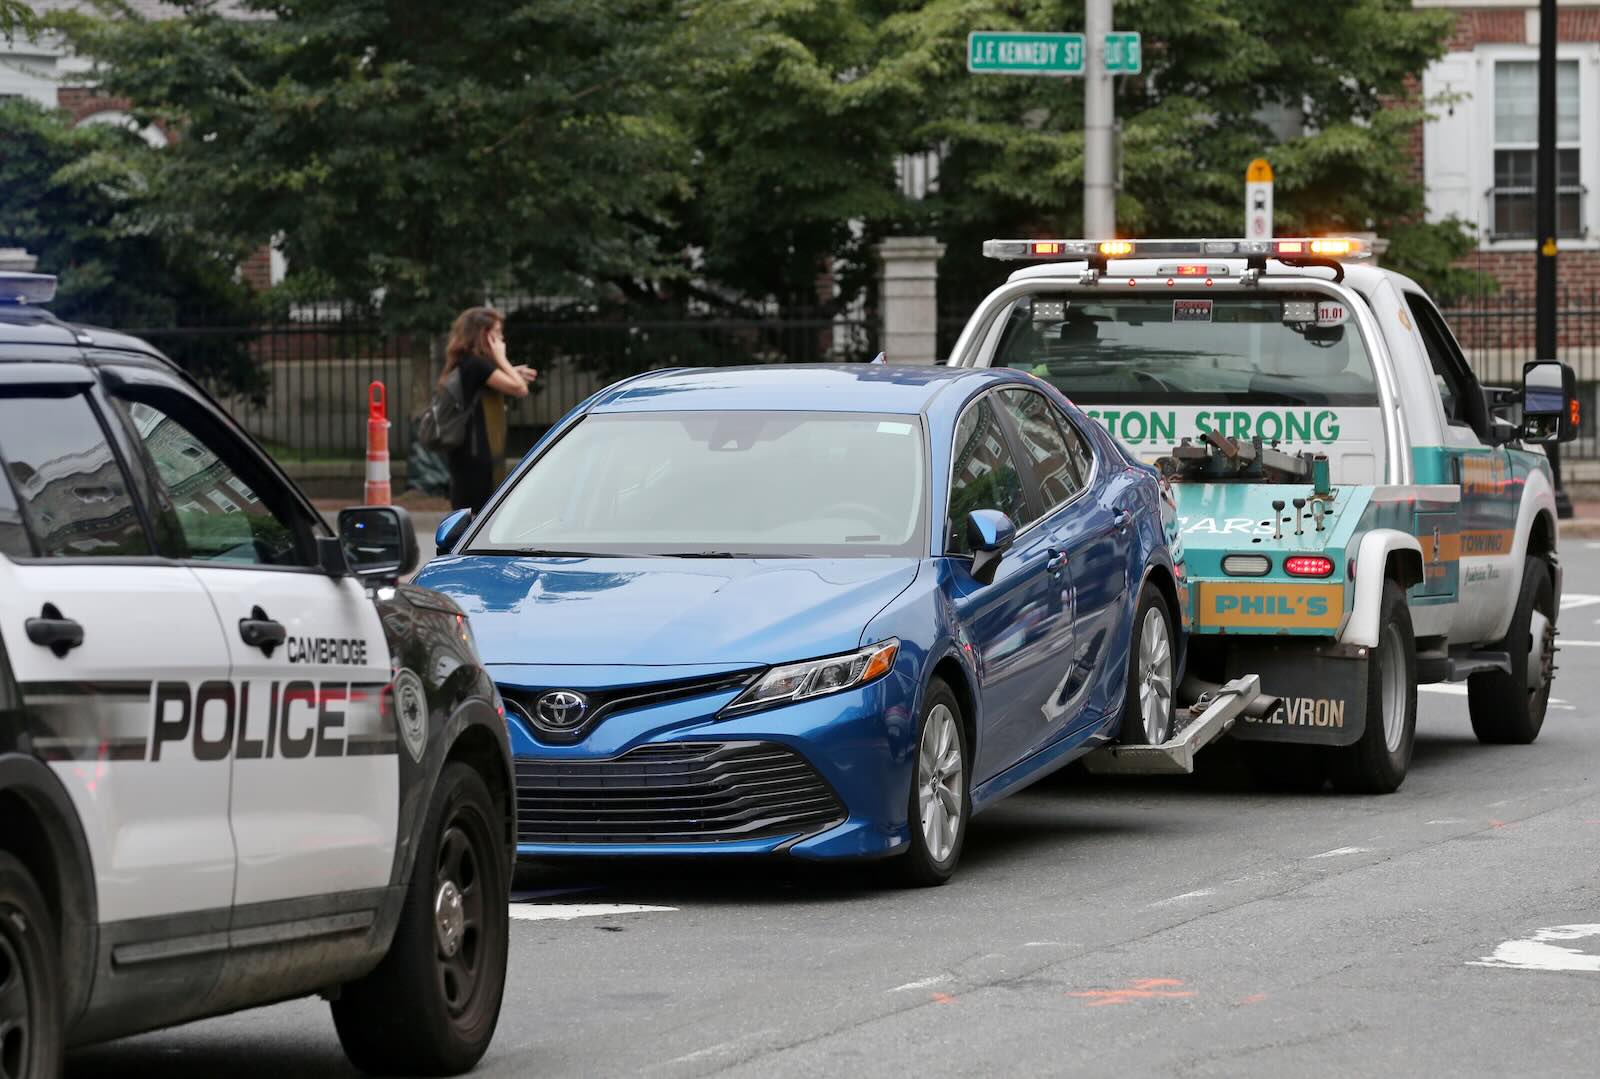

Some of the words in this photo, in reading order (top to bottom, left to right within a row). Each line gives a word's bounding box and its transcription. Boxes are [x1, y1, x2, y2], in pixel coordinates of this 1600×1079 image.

[998, 42, 1058, 64] KENNEDY
[1064, 42, 1080, 65] ST
[1195, 411, 1341, 445] STRONG
[1460, 535, 1503, 552] TOWING
[1215, 595, 1328, 616] PHIL'S
[287, 636, 368, 666] CAMBRIDGE
[151, 680, 348, 762] POLICE
